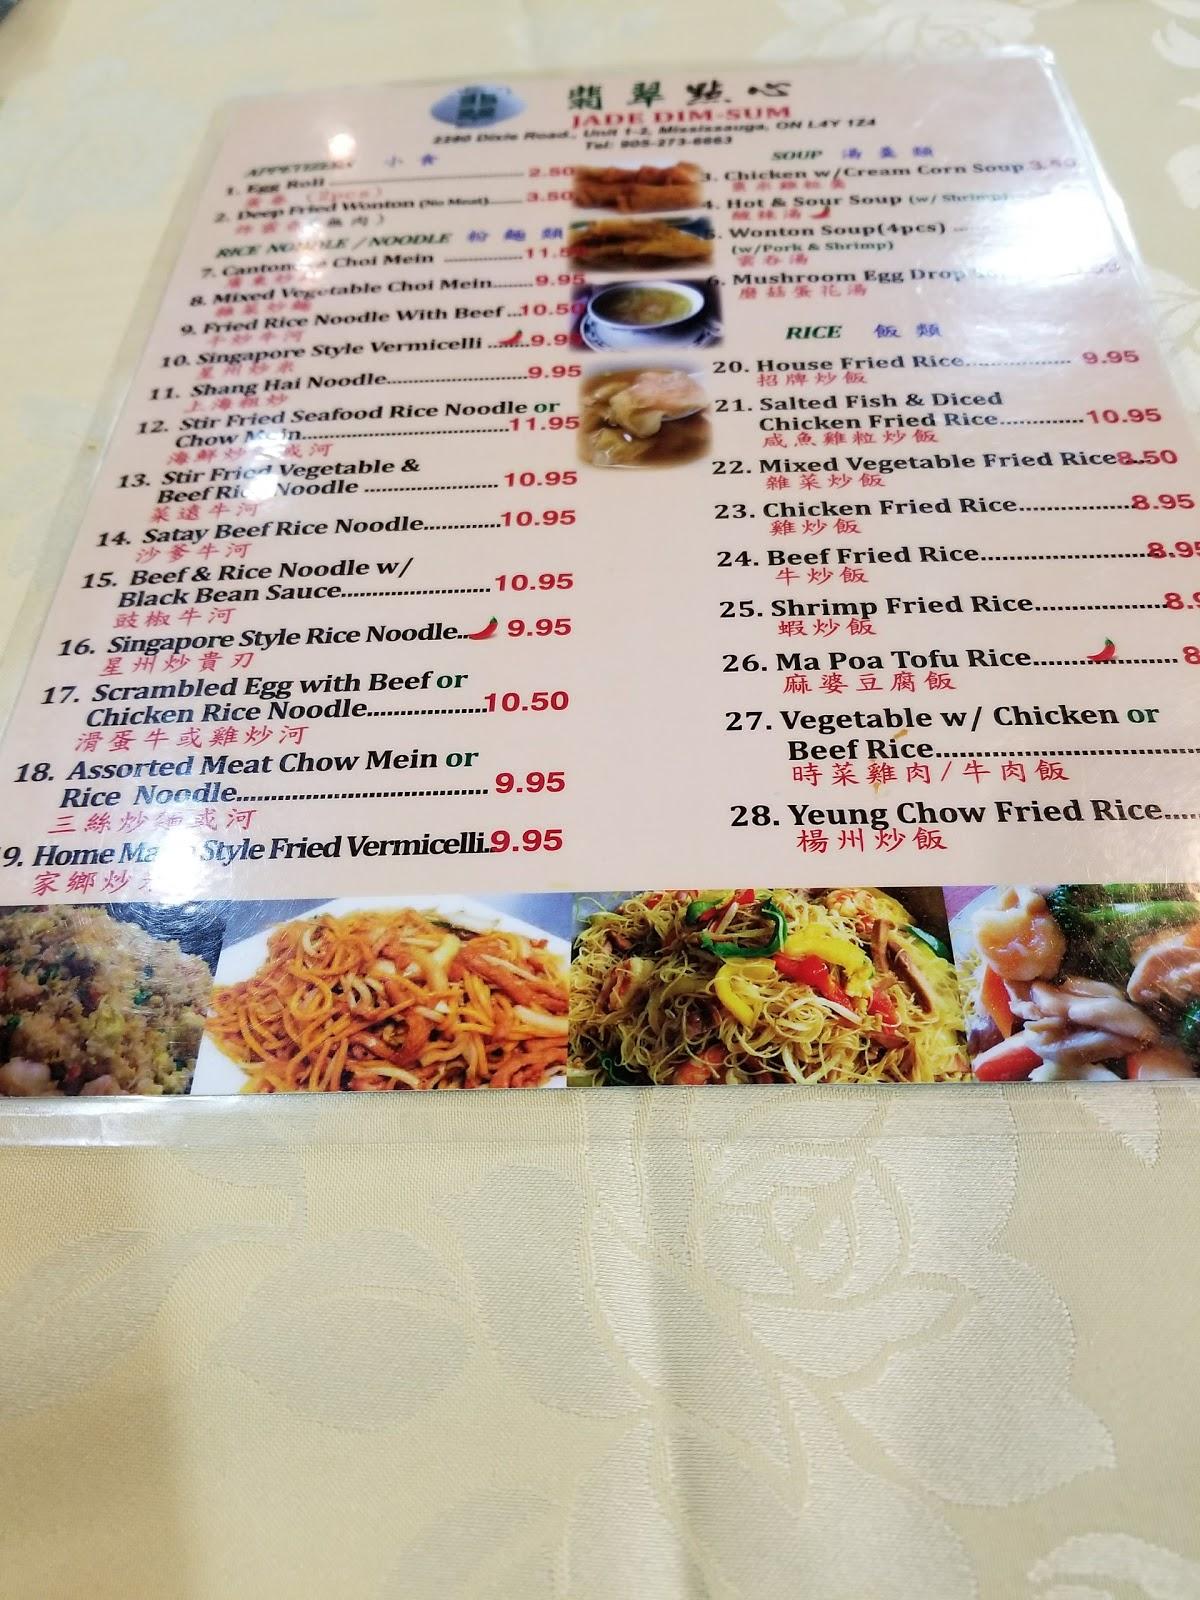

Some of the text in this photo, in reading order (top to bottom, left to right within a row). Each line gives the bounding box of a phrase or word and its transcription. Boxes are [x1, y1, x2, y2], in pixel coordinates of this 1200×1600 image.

[567, 81, 791, 110] 翡翠點心
[572, 106, 791, 128] JADE DIM-SUM
[477, 134, 518, 142] Dixie
[584, 128, 617, 138] Unit
[776, 121, 802, 130] ON
[808, 120, 840, 129] L4Y
[848, 119, 876, 127] 1Z4
[586, 141, 613, 150] Tel:
[771, 150, 823, 161] SOUP
[724, 163, 1024, 181] Chicken w/Cream Corn Soup
[248, 184, 280, 193] Egg
[287, 179, 325, 189] Roll
[238, 209, 284, 220] Deep
[343, 201, 415, 211] Wonton
[727, 199, 764, 209] Hot
[772, 198, 786, 208] &
[794, 197, 843, 207] Sour
[848, 194, 902, 207] Soup
[729, 221, 946, 239] Wonton Soup(4pcs)
[216, 245, 262, 258] RICE
[808, 243, 820, 251] &
[825, 241, 894, 251] Shrimp)
[333, 253, 434, 267] Choi Mein
[733, 269, 966, 285] Mushroom Egg Drop
[213, 274, 586, 305] Mixed Choi Mein 9.95
[203, 306, 505, 334] Fried Rice Noodle With Beef
[873, 323, 942, 339] 飯類
[785, 325, 842, 340] RICE
[196, 337, 482, 368] Singapore Style Vermicelli
[758, 351, 1140, 372] House Fried 9.95
[190, 366, 582, 398] Shang Hai Noodle 9.95
[760, 391, 1003, 411] Salted Fish Diced
[179, 401, 527, 430] Stir Fried Seafood Rice Noodle
[759, 408, 1162, 432] Chicken Fried Rice 10.95
[175, 417, 580, 448] Chow 11.95
[162, 460, 395, 485] Stir Vegetable
[759, 451, 1053, 473] Mixed Vegetable Fried
[157, 471, 578, 504] Beef 10.95
[763, 494, 1195, 518] Chicken Fried Rice 8.95
[142, 509, 576, 544] Satay Beef Rice Noodle 10.95
[770, 518, 861, 535] 雞炒飯
[768, 545, 980, 567] Beef Fried Rice
[130, 557, 370, 586] Beef Rice Noodle
[775, 568, 869, 585] 牛炒飯
[118, 573, 574, 608] Black Bean Sauce 10.95
[771, 595, 1034, 619] Shrimp Fried Rice
[107, 618, 571, 656] Singapore Style Rice Noodle 9.95
[778, 618, 877, 637] 蝦炒飯
[777, 649, 1032, 671] Ma Poa Tofu Rice
[91, 670, 434, 701] Scrambled Egg with Beef
[783, 671, 956, 694] 麻婆豆腐飯
[86, 691, 569, 727] Chicken Rice Noodle 10.50
[780, 706, 1159, 735] Vegetable Chicken or
[74, 725, 309, 752] 滑蛋牛或雞炒河
[788, 739, 934, 760] Beef Rice
[65, 747, 479, 781] Assorted Meat Chow Mein or
[59, 772, 566, 808] Rice 9.95
[787, 799, 1163, 831] Yeung Chow Fried Rice
[31, 832, 484, 867] Home Fried Vermicelli
[796, 829, 948, 853] 楊州炒飯
